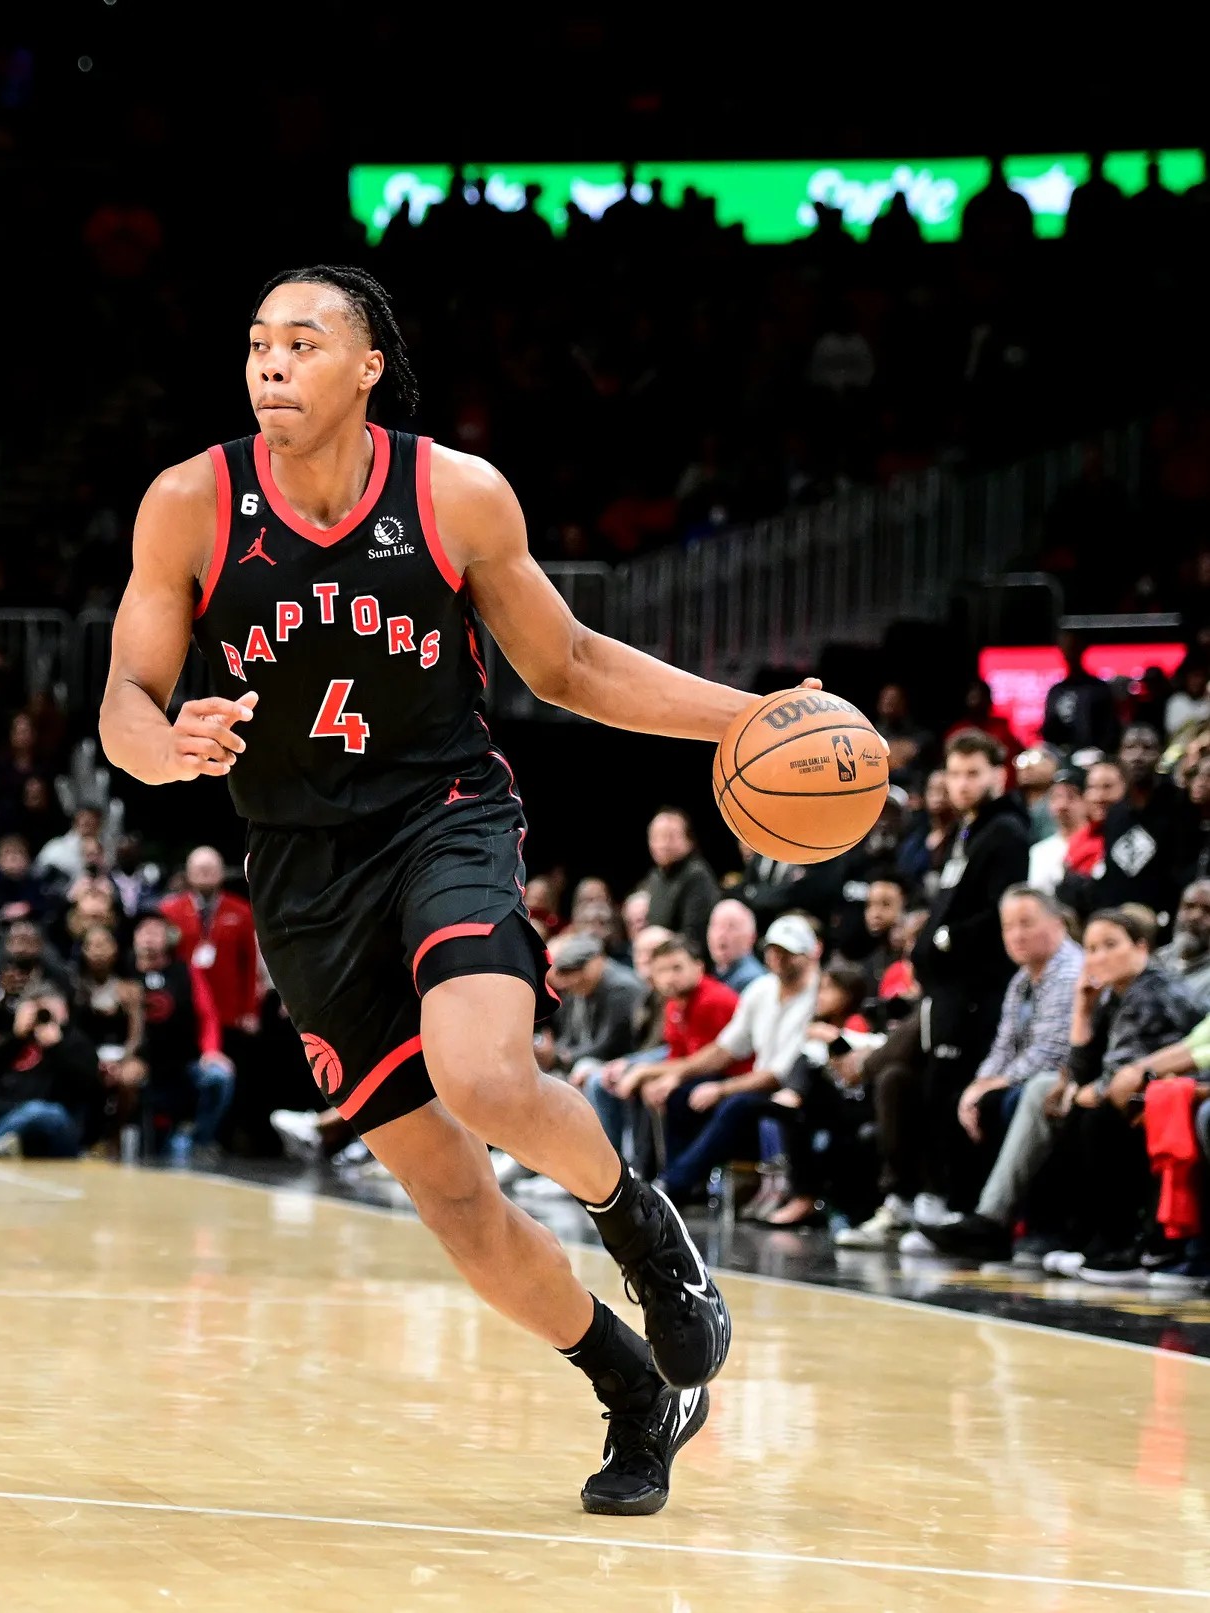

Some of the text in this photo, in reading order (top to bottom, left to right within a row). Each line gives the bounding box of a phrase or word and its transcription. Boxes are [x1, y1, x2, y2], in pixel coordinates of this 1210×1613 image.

[240, 493, 259, 516] 6
[368, 544, 415, 559] Sun Life
[221, 582, 441, 682] RAPTORS
[309, 679, 370, 754] 4
